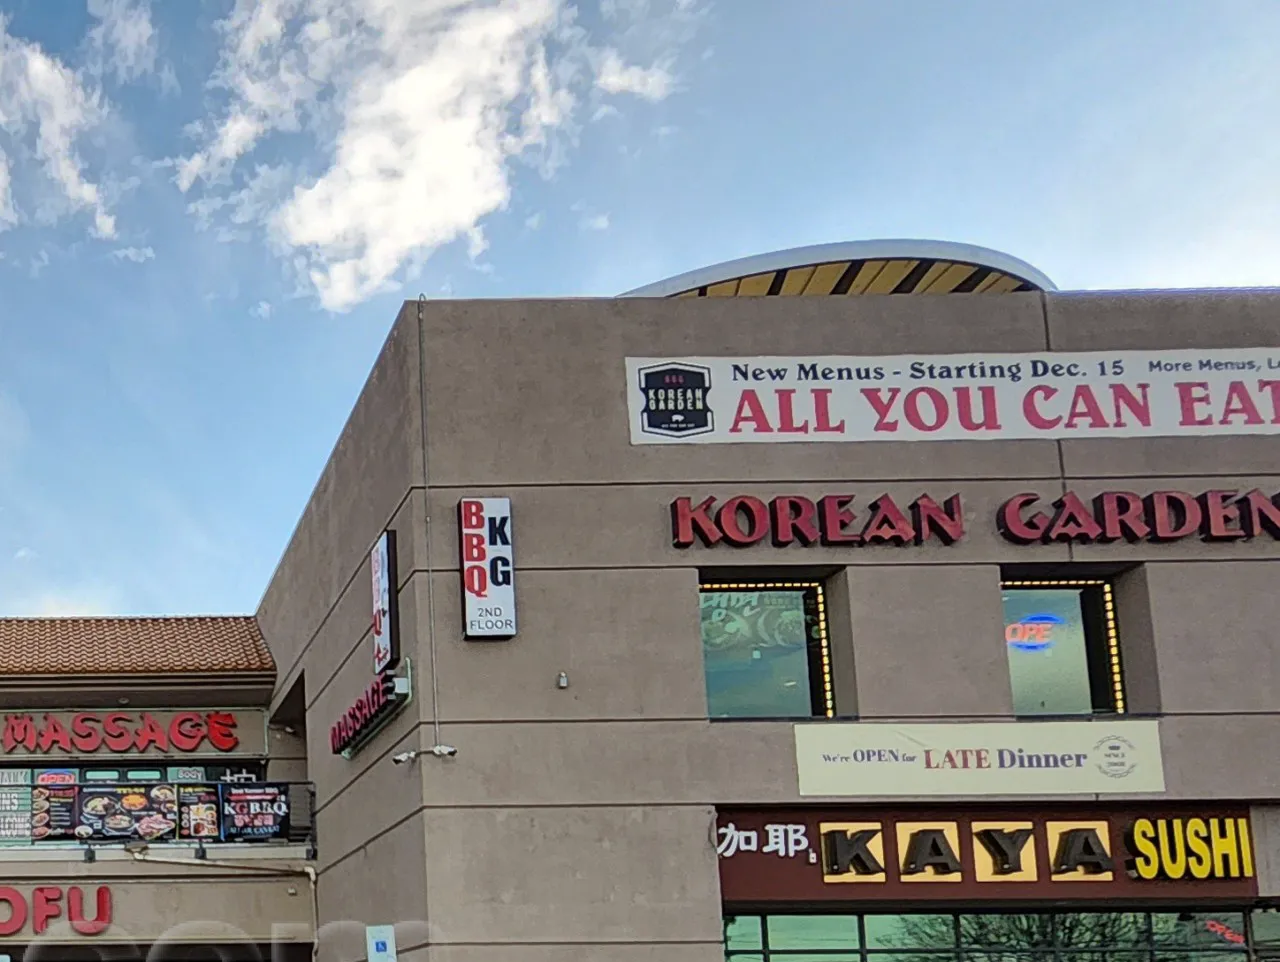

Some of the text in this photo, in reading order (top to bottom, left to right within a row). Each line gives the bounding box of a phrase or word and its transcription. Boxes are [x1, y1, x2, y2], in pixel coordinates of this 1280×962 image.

[731, 363, 788, 381] New
[797, 362, 885, 381] Menus
[909, 360, 1022, 382] Starting
[1030, 359, 1087, 378] Dec.
[1097, 360, 1124, 376] 15
[1148, 360, 1193, 372] More
[1197, 359, 1262, 373] Menus,
[648, 388, 703, 400] KOREAN
[648, 399, 703, 411] GARDEN
[729, 388, 846, 434] ALL
[859, 386, 1002, 432] YOU
[1022, 383, 1152, 430] CAN
[671, 488, 1280, 548] KOREAN GARDEN
[462, 500, 488, 598] BBQ
[476, 606, 503, 618] 2ND
[469, 619, 514, 631] FLOOR
[331, 672, 388, 753] MASSAGE
[1, 711, 239, 753] MASSAGE
[822, 748, 1088, 769] We're OPEN for LATE Dinner
[37, 772, 76, 785] OPEN
[177, 769, 202, 780] Body
[821, 817, 1254, 880] KAYA SUSHI
